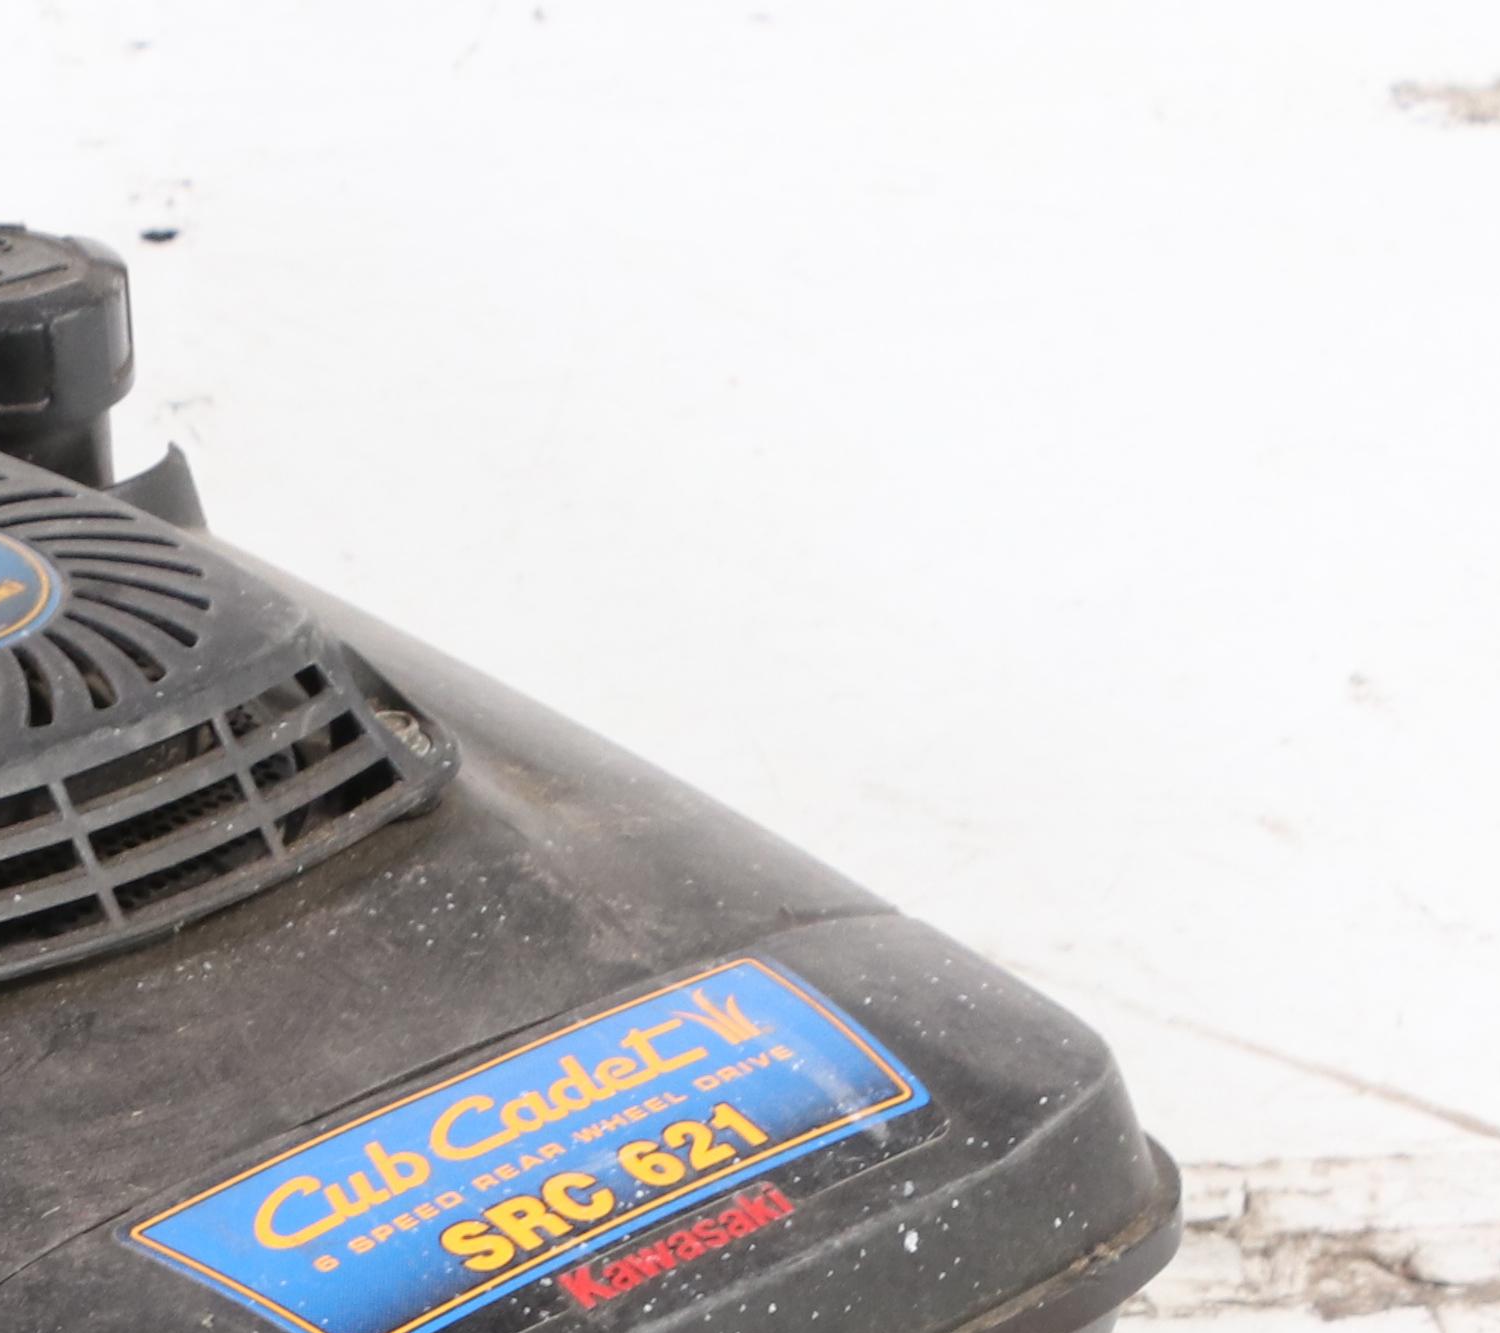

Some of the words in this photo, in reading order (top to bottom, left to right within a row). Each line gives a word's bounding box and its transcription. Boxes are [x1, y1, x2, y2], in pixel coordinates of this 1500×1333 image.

[254, 1140, 431, 1249] Cub
[429, 1017, 709, 1161] Cadet
[347, 1190, 465, 1255] SPEED
[471, 1142, 568, 1192] REAR
[571, 1091, 689, 1144] WHEEL
[692, 1044, 796, 1092] DRIVE
[439, 1170, 617, 1274] SRC
[617, 1101, 770, 1188] 621
[557, 1180, 796, 1311] Kawasaki
